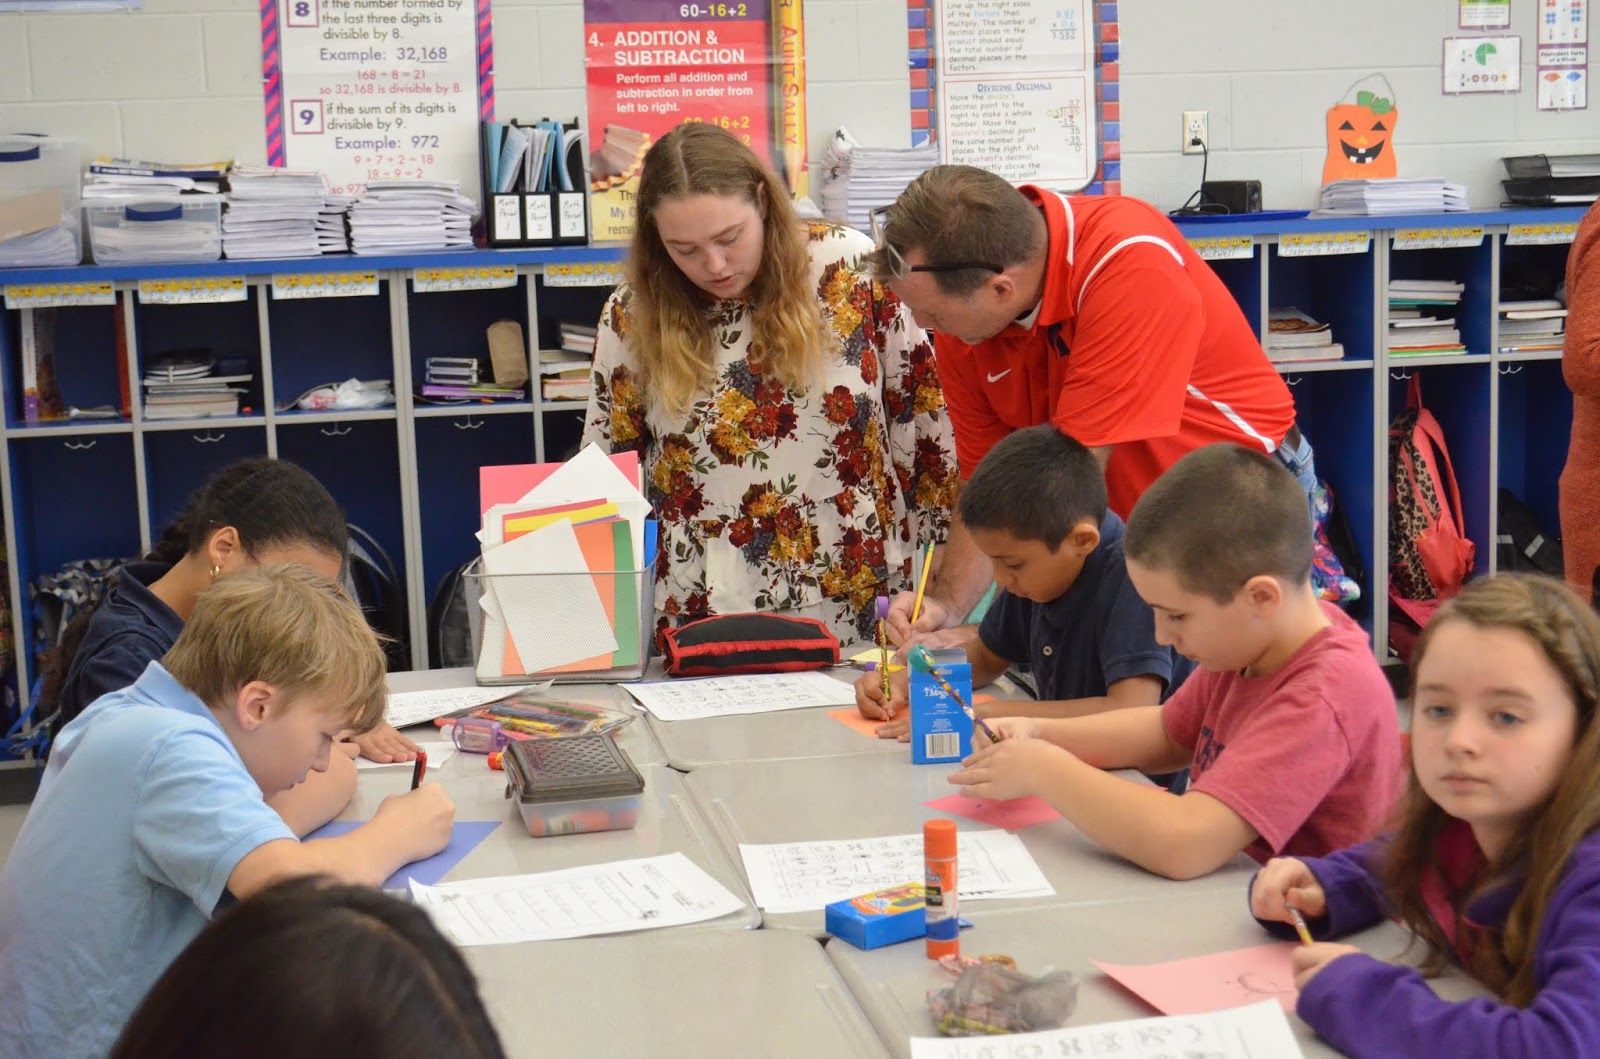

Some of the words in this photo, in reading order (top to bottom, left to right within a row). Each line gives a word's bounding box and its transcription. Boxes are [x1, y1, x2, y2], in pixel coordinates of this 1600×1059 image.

[295, 1, 310, 17] 8
[332, 0, 350, 8] the
[354, 0, 398, 8] number
[402, 0, 444, 8] formed
[448, 0, 462, 11] by
[992, 1, 1009, 9] right
[322, 12, 340, 24] the
[345, 12, 364, 24] last
[367, 12, 397, 24] three
[400, 12, 431, 27] digits
[434, 12, 443, 23] is
[323, 27, 369, 39] divisible
[373, 27, 388, 42] by
[392, 28, 404, 39] 8.
[978, 28, 1001, 36] places
[588, 32, 604, 47] 4.
[614, 30, 700, 46] ADDITION
[705, 30, 718, 45] &
[948, 38, 976, 47] product
[1005, 36, 1024, 45] equal
[320, 47, 386, 64] Example:
[397, 46, 447, 62] 32,168
[780, 24, 797, 77] AUNT
[614, 48, 745, 66] SUBTRACTION
[948, 55, 976, 63] decimal
[979, 55, 1002, 63] places
[357, 69, 377, 80] 168
[392, 69, 399, 80] 8
[413, 69, 426, 80] 21
[616, 74, 661, 84] Perform
[664, 72, 677, 82] all
[679, 72, 724, 82] addition
[727, 71, 748, 82] and
[319, 87, 332, 95] so
[378, 84, 385, 94] is
[389, 83, 432, 94] divisible
[436, 82, 449, 96] by
[453, 82, 463, 93] 8.
[616, 88, 679, 99] subtraction
[682, 87, 693, 97] in
[695, 86, 725, 97] order
[727, 86, 753, 96] from
[326, 103, 333, 114] if
[336, 103, 354, 114] the
[359, 106, 381, 114] sum
[385, 101, 396, 114] of
[399, 103, 412, 113] its
[415, 102, 445, 117] digits
[448, 102, 456, 113] is
[617, 102, 635, 113] left
[637, 103, 649, 112] to
[652, 102, 680, 114] right.
[980, 102, 998, 110] point
[299, 109, 315, 125] 9
[782, 83, 799, 144] SALLY
[951, 112, 968, 121] right
[327, 117, 373, 130] divisible
[377, 117, 391, 132] by
[395, 117, 407, 129] 9.
[1018, 127, 1036, 135] point
[335, 135, 400, 152] Example:
[411, 135, 439, 148] 972
[952, 147, 974, 155] places
[354, 155, 361, 166] 9
[376, 155, 383, 165] 7
[398, 154, 405, 165] 2
[421, 154, 434, 164] 18
[367, 169, 379, 179] 18
[394, 169, 401, 178] 9
[416, 168, 423, 178] 2
[1019, 171, 1036, 179] point
[610, 207, 625, 220] My
[537, 224, 544, 232] 2
[570, 222, 576, 231] 3
